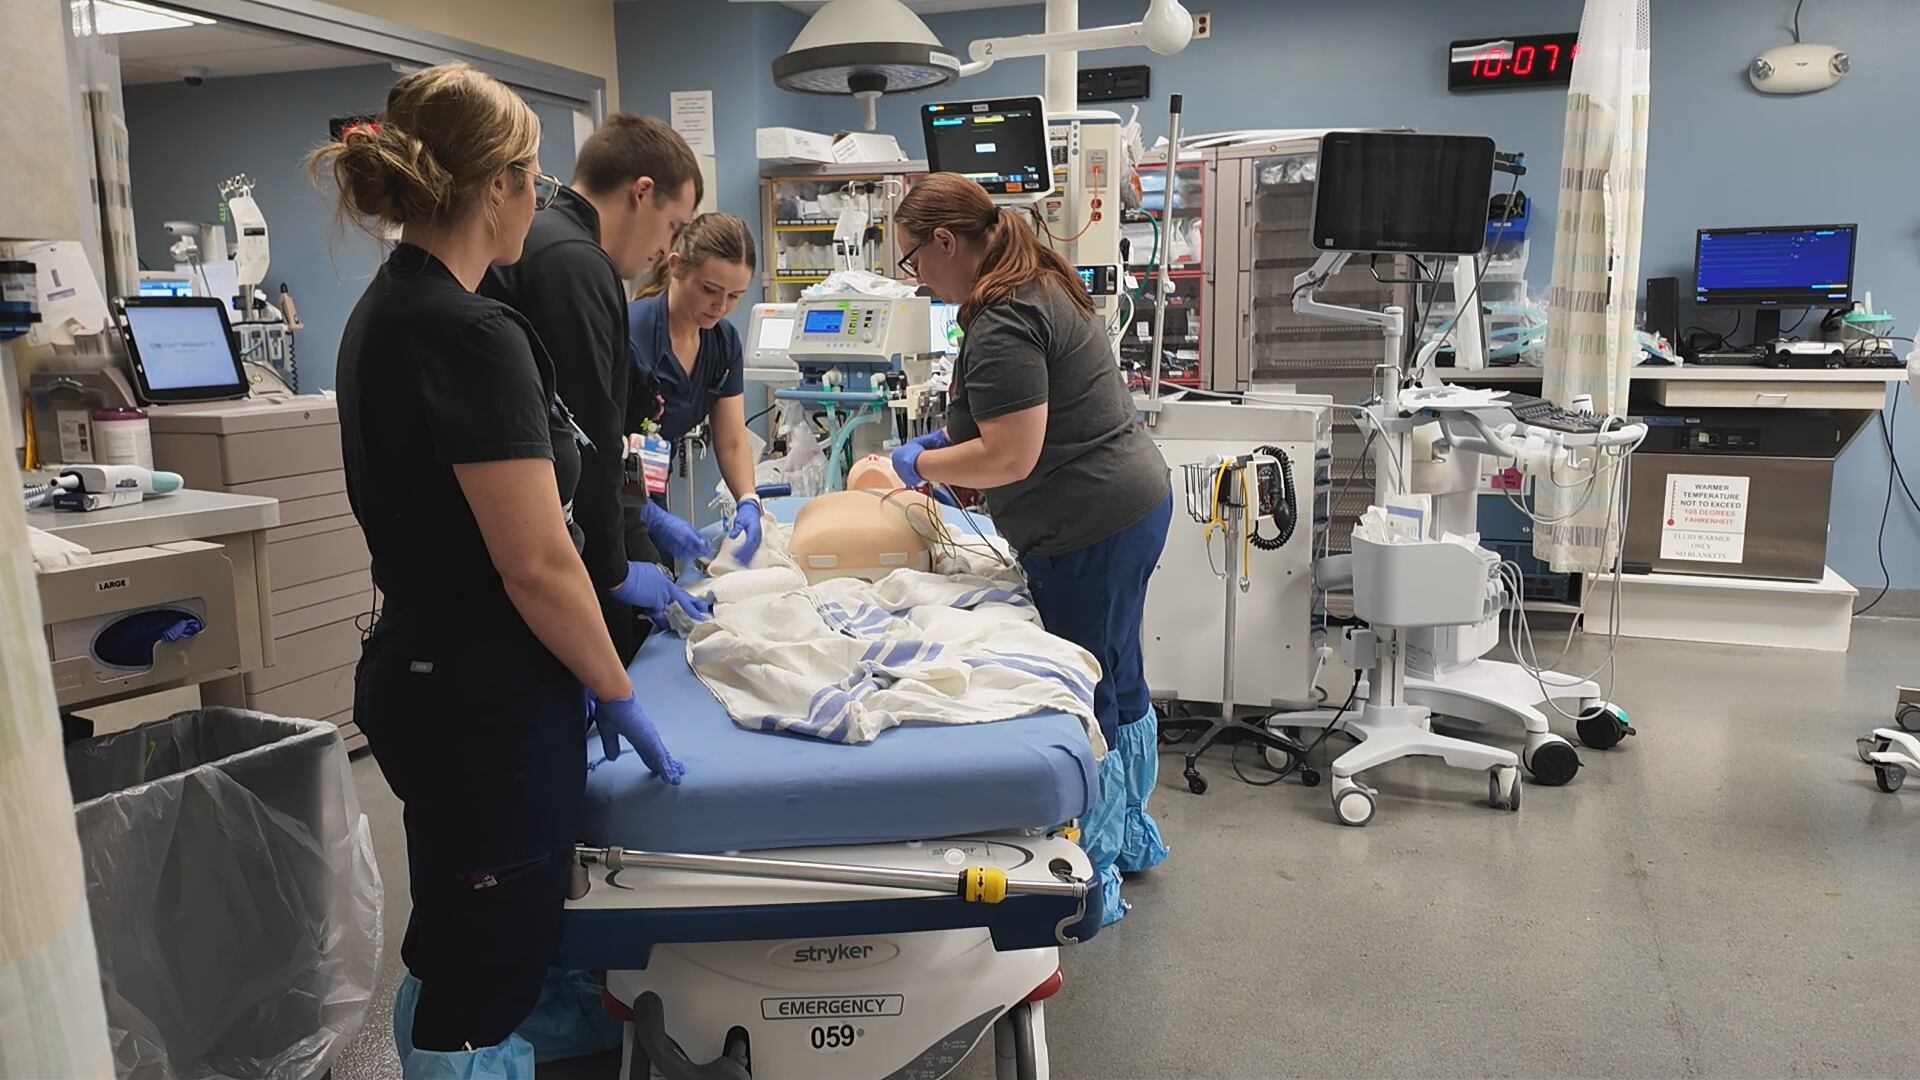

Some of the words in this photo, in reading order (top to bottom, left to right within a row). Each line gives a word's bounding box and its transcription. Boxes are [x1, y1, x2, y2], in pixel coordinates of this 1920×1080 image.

[985, 43, 993, 55] 2
[1683, 491, 1740, 500] TEMPERATURE
[1699, 509, 1736, 517] DEGREES
[1684, 517, 1734, 525] FAHRENHEIT
[1687, 551, 1727, 559] BLANKETS
[99, 580, 126, 590] LARGE
[793, 944, 874, 964] stryker
[779, 999, 886, 1015] EMERGENCY
[811, 1024, 855, 1049] 059
